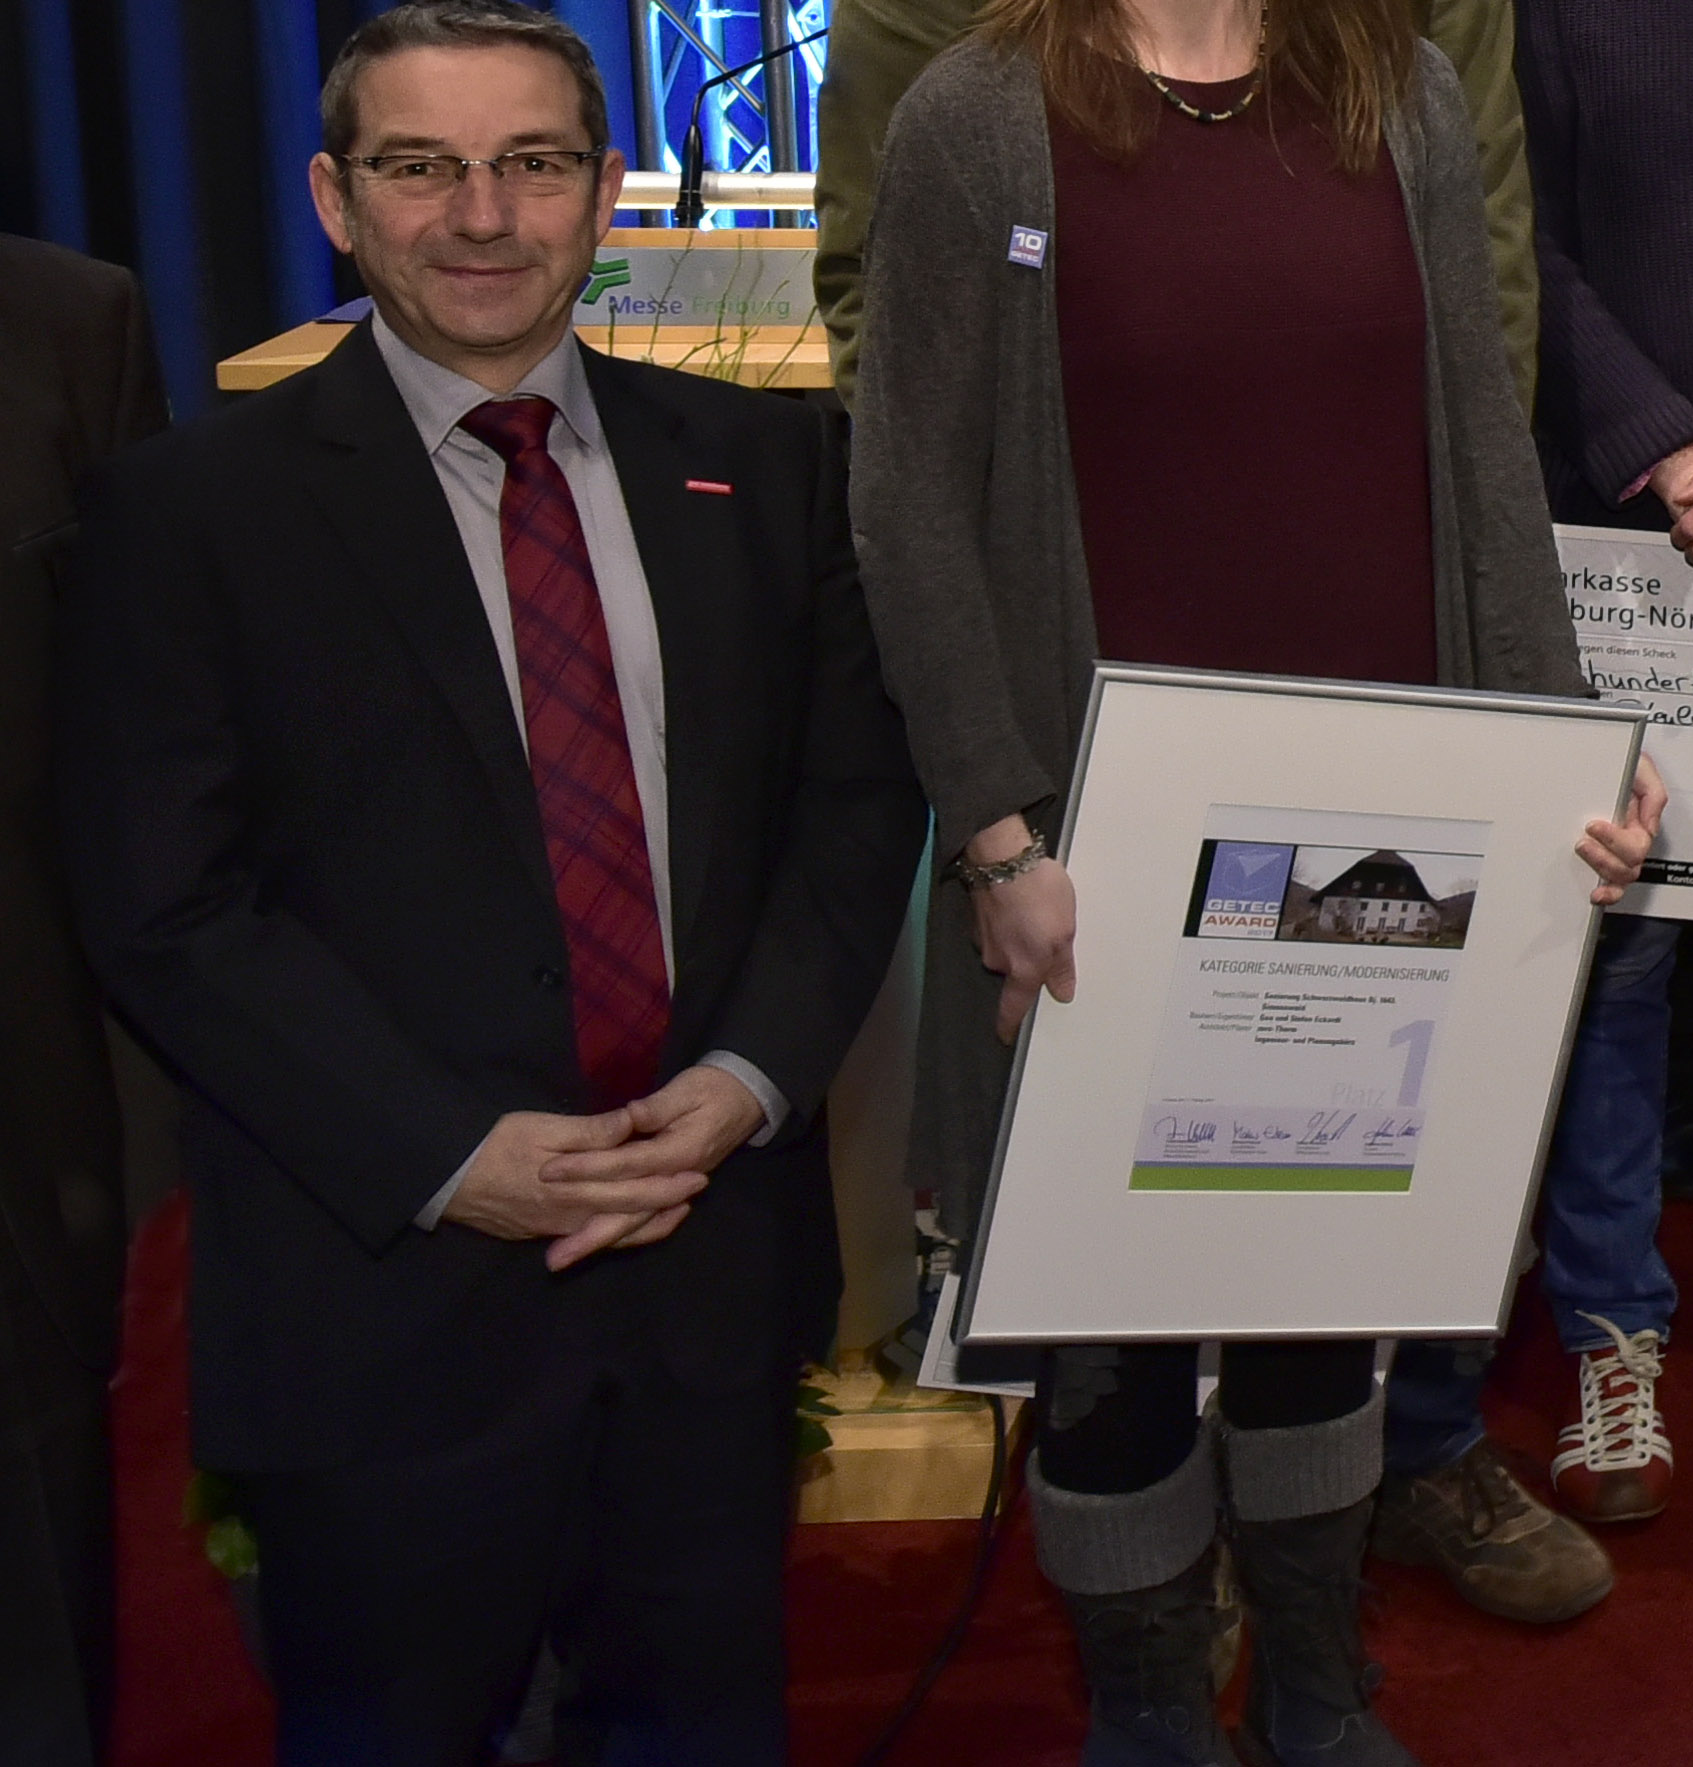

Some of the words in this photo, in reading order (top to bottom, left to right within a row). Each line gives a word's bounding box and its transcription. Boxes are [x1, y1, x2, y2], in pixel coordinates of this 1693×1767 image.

[1014, 232, 1042, 251] 10
[608, 295, 682, 315] Messe
[691, 295, 790, 321] Freiburg
[1606, 645, 1641, 657] diesen
[1642, 647, 1677, 661] Scheck
[1206, 899, 1280, 914] GETEC
[1204, 914, 1277, 928] AWARD
[1199, 959, 1266, 975] KATEGORIE
[1267, 961, 1450, 983] SANIERUNG/MODERNISIERUNG
[1388, 1018, 1437, 1109] 1
